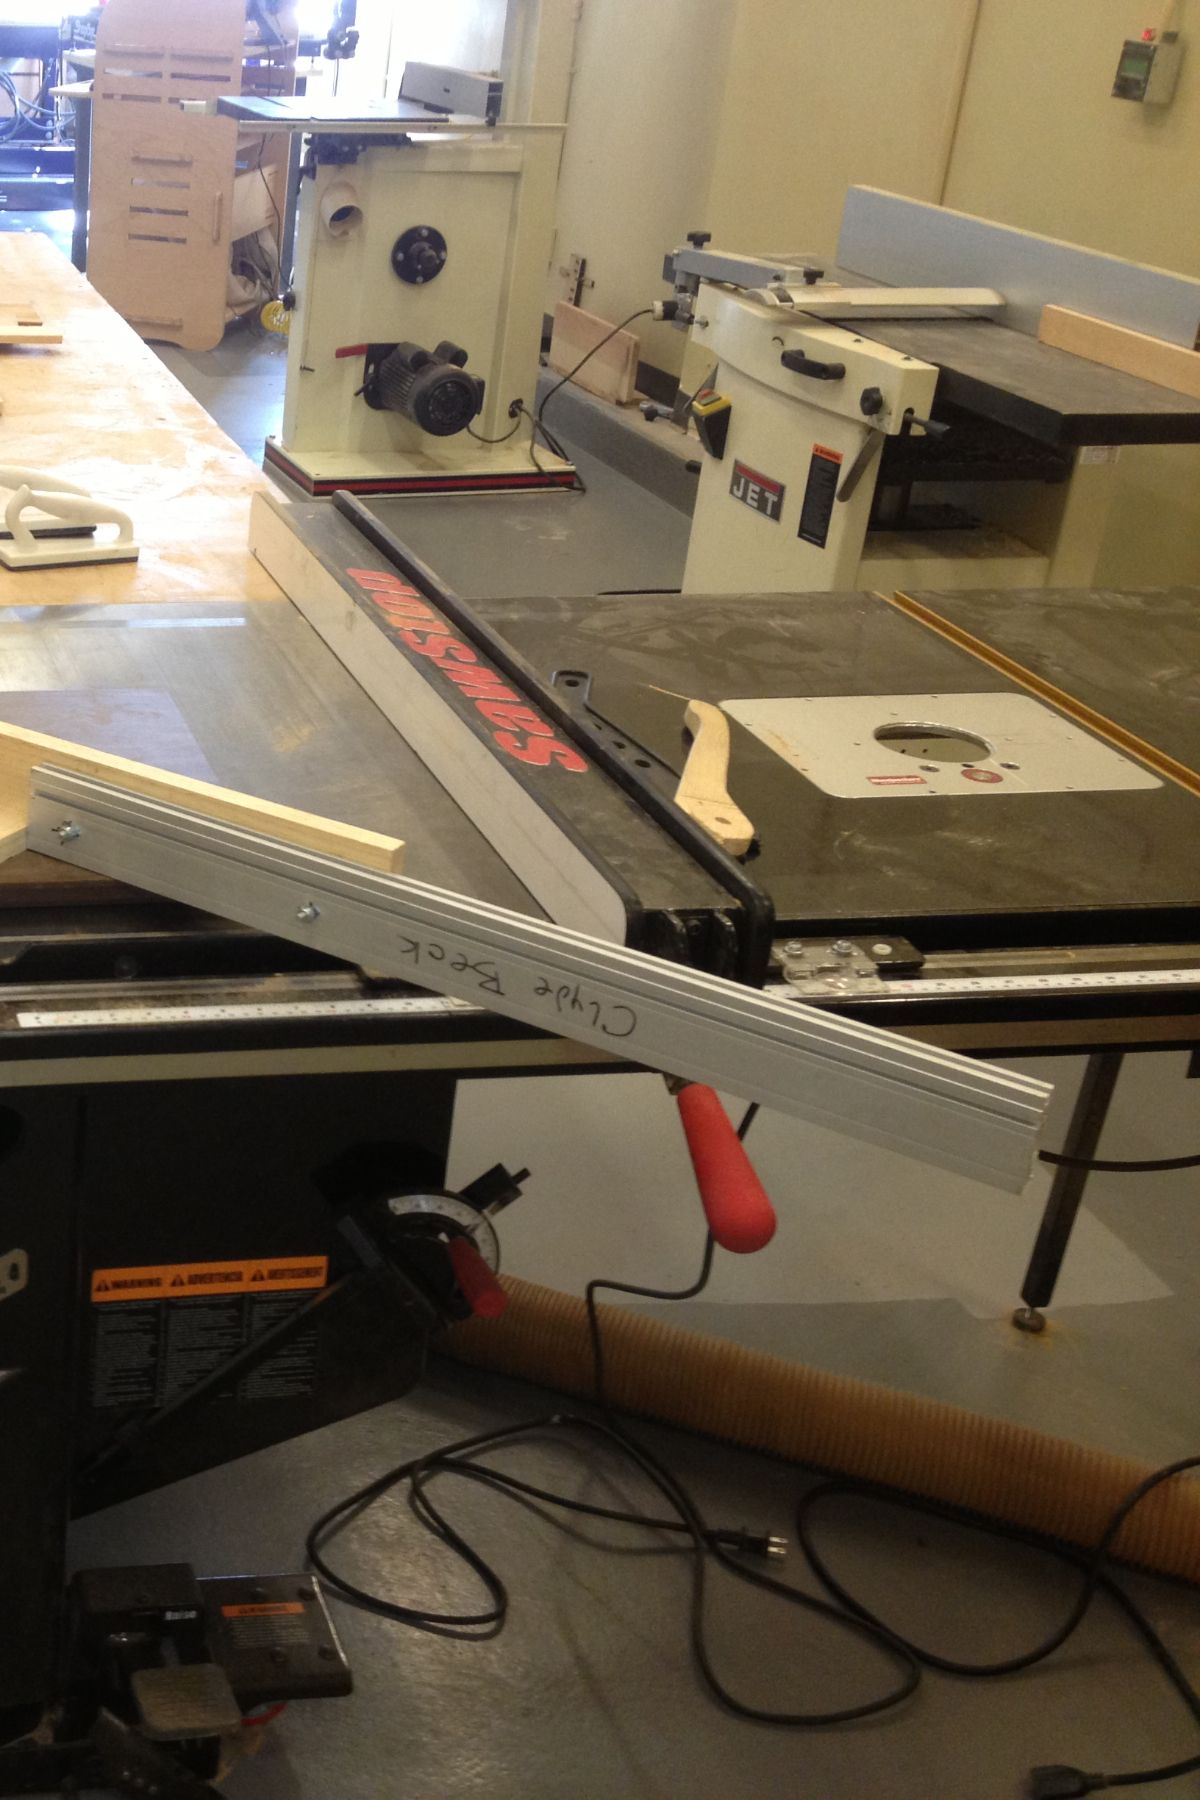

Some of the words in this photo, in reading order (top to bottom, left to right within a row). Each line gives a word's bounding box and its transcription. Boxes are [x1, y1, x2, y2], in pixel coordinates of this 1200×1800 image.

[732, 478, 779, 515] JET
[346, 567, 589, 773] SawStop
[397, 934, 506, 996] Beck
[532, 976, 638, 1038] Clyde
